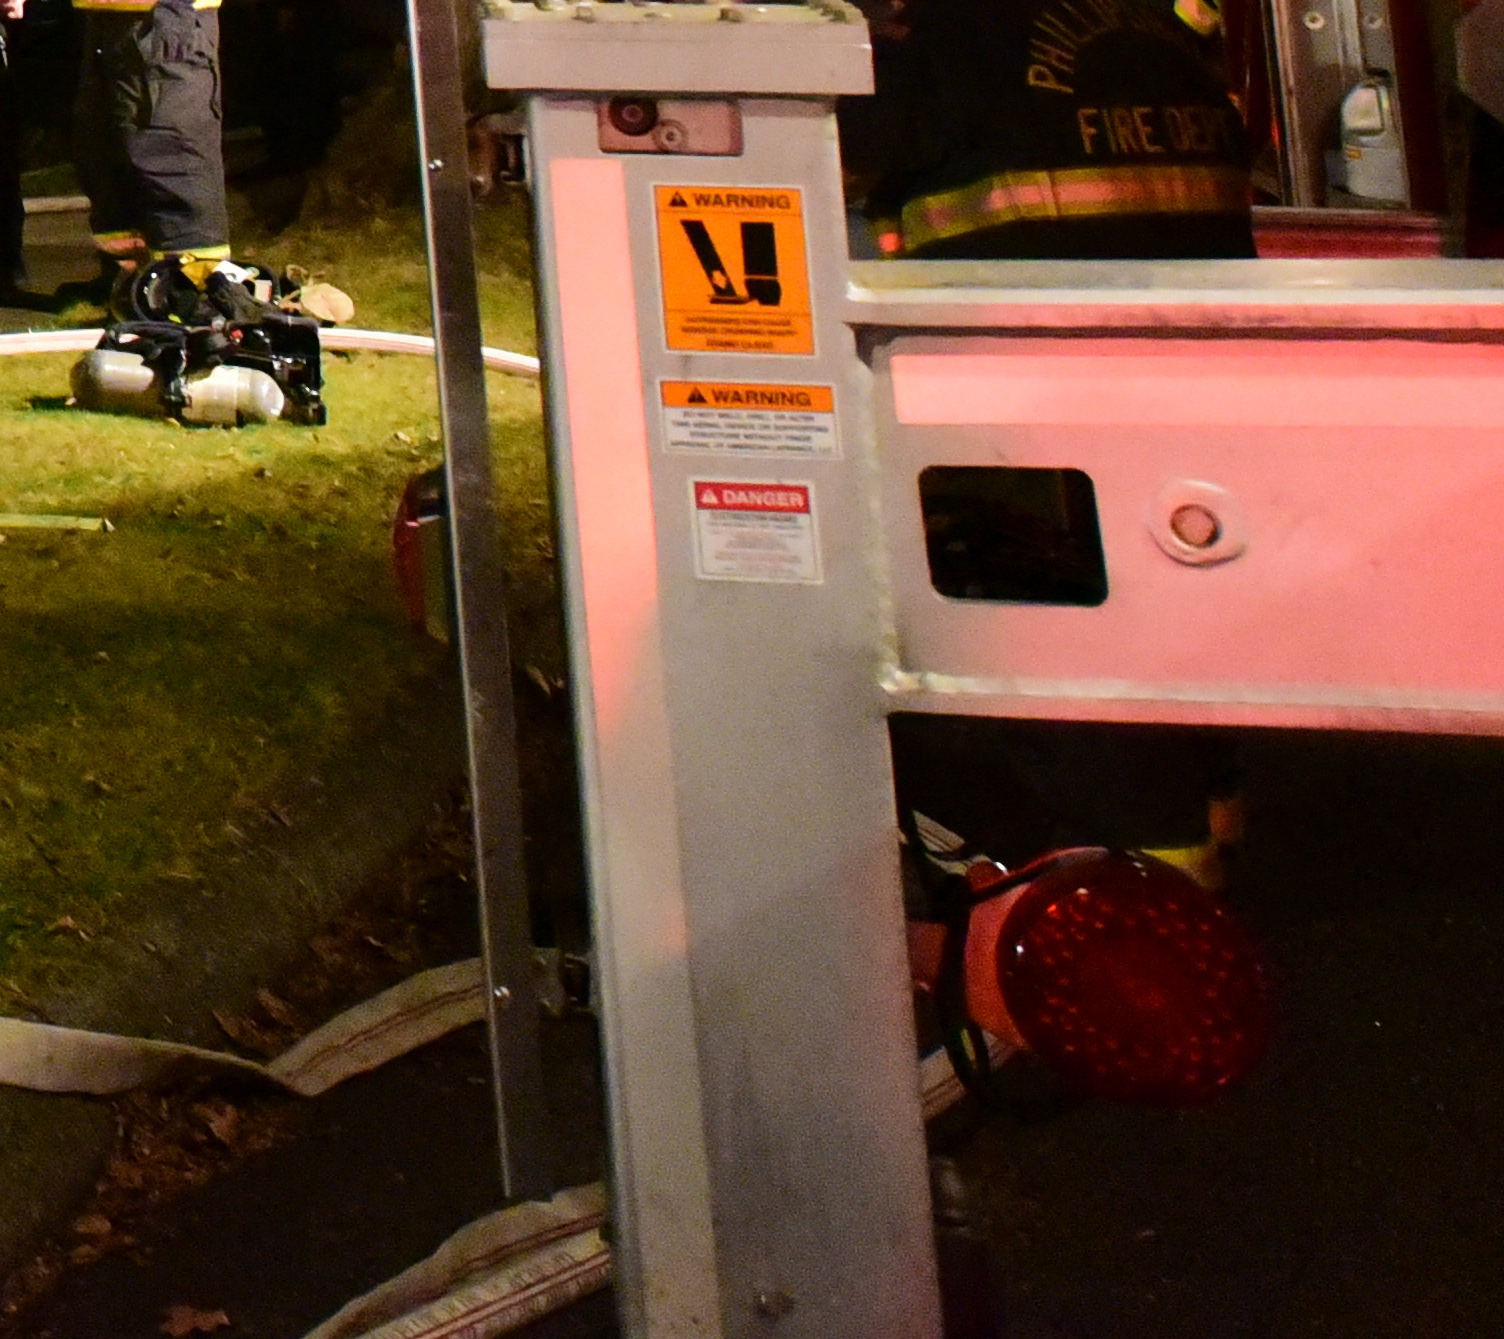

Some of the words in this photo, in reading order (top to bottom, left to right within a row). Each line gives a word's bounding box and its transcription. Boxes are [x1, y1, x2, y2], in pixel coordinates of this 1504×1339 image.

[1077, 106, 1166, 155] FIRE
[693, 193, 791, 210] WARNING
[710, 388, 813, 407] WARNING
[721, 488, 805, 508] DANGER
